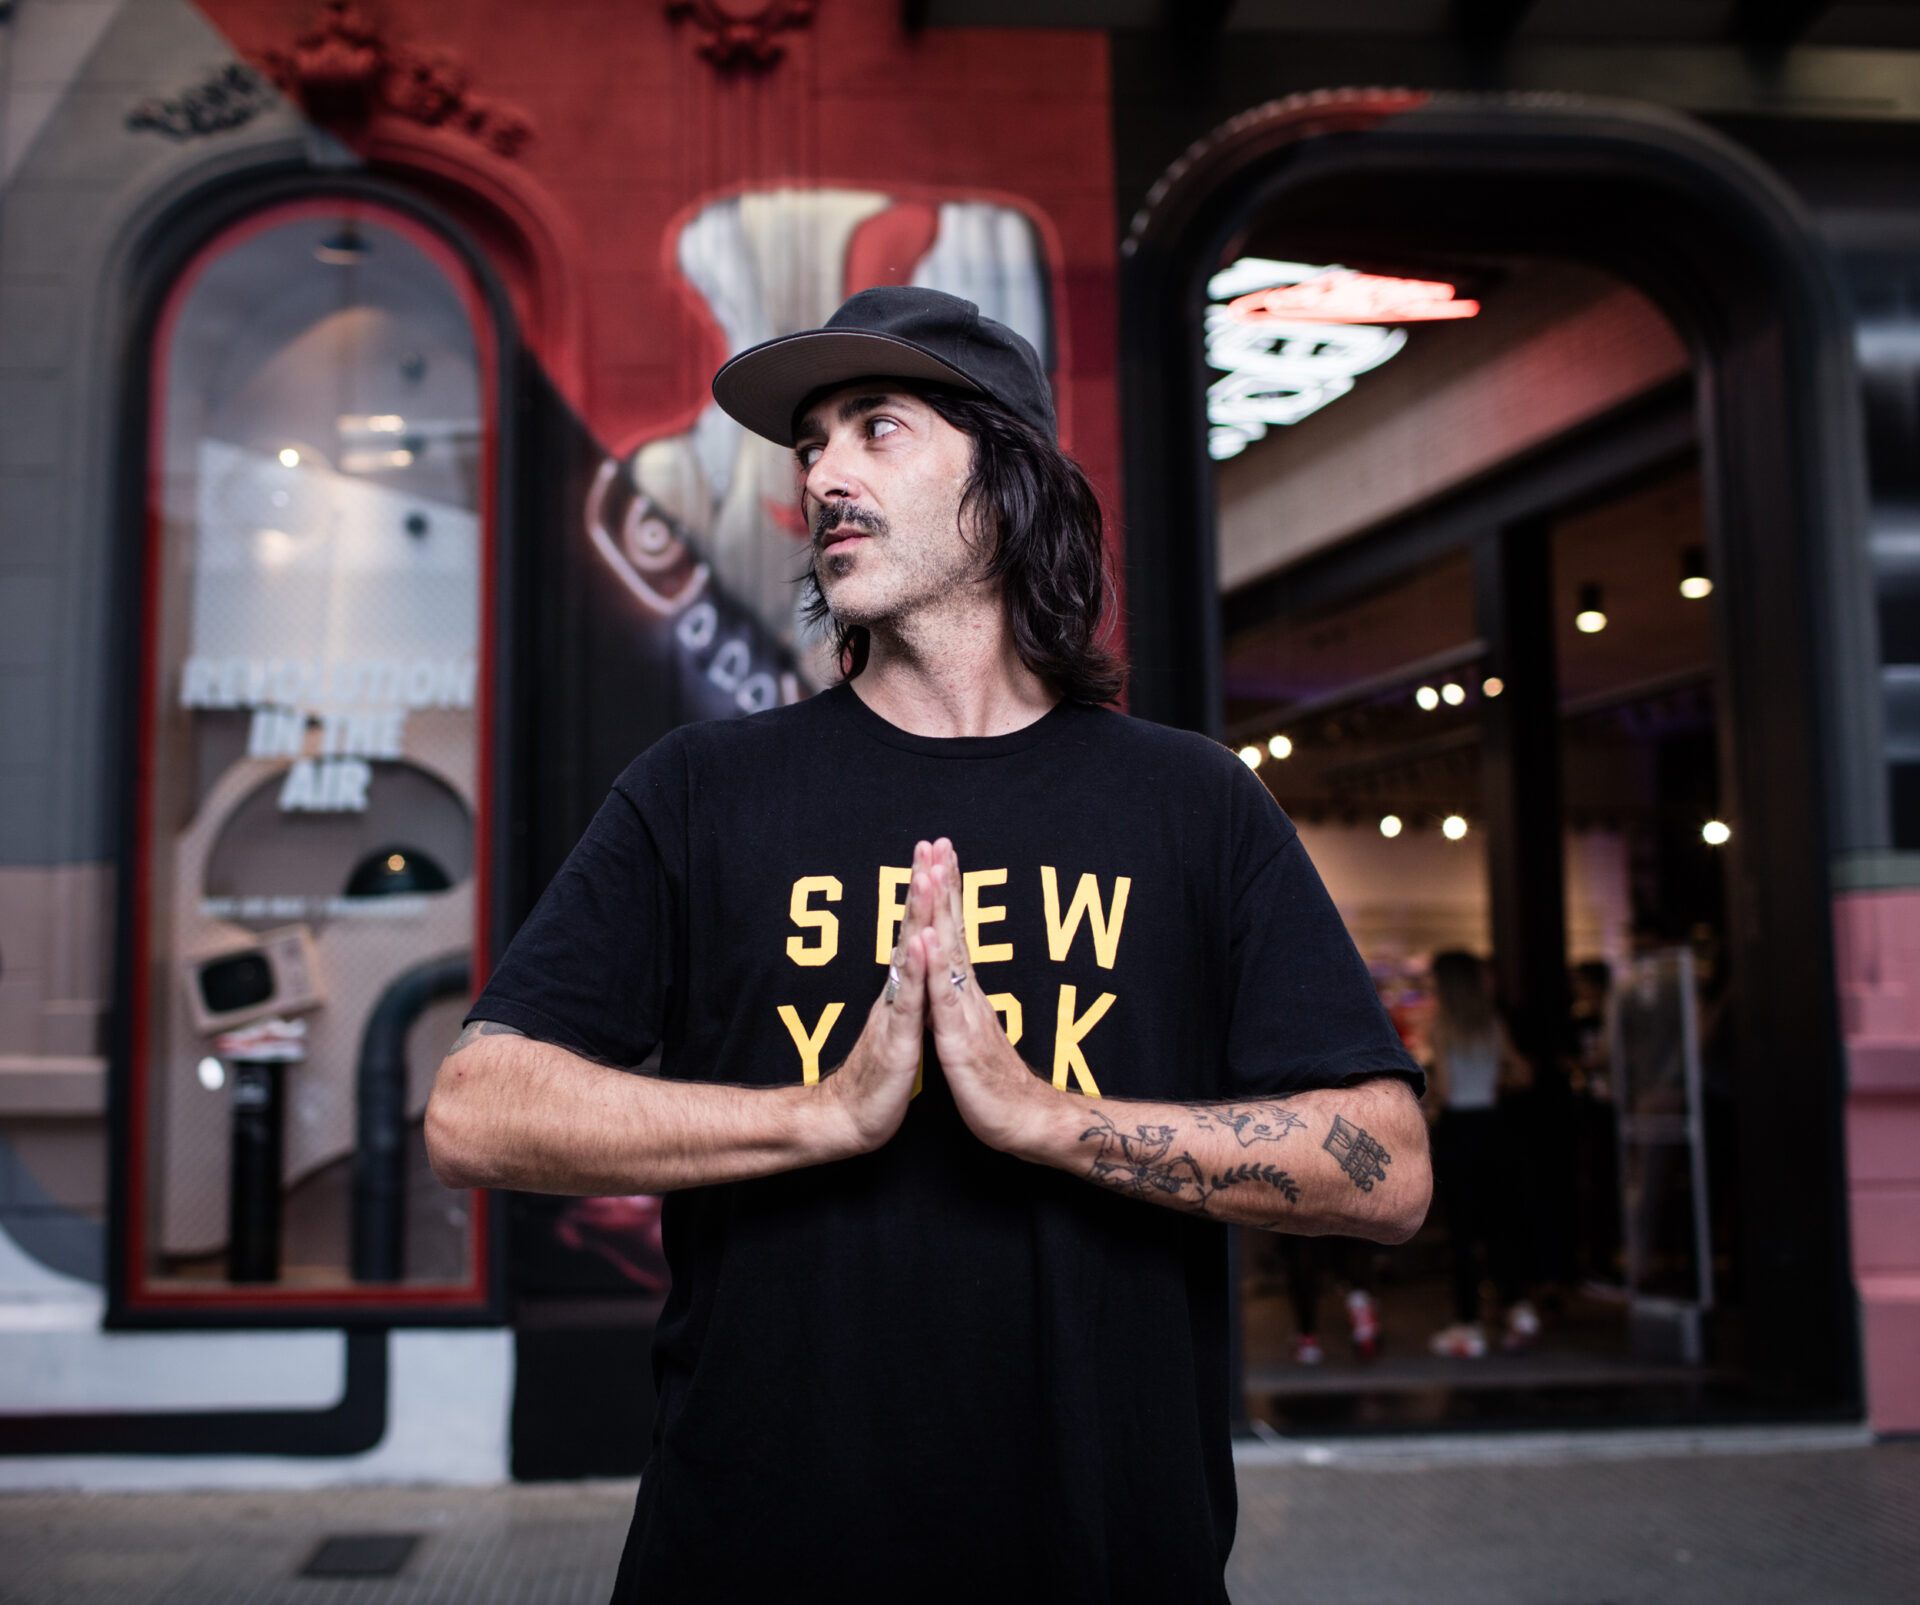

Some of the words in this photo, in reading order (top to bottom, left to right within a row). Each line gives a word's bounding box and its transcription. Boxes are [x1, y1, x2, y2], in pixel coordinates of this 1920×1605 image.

[249, 711, 299, 758] IN
[320, 711, 407, 759] THE
[277, 760, 372, 811] AIR
[777, 984, 1117, 1099] YK
